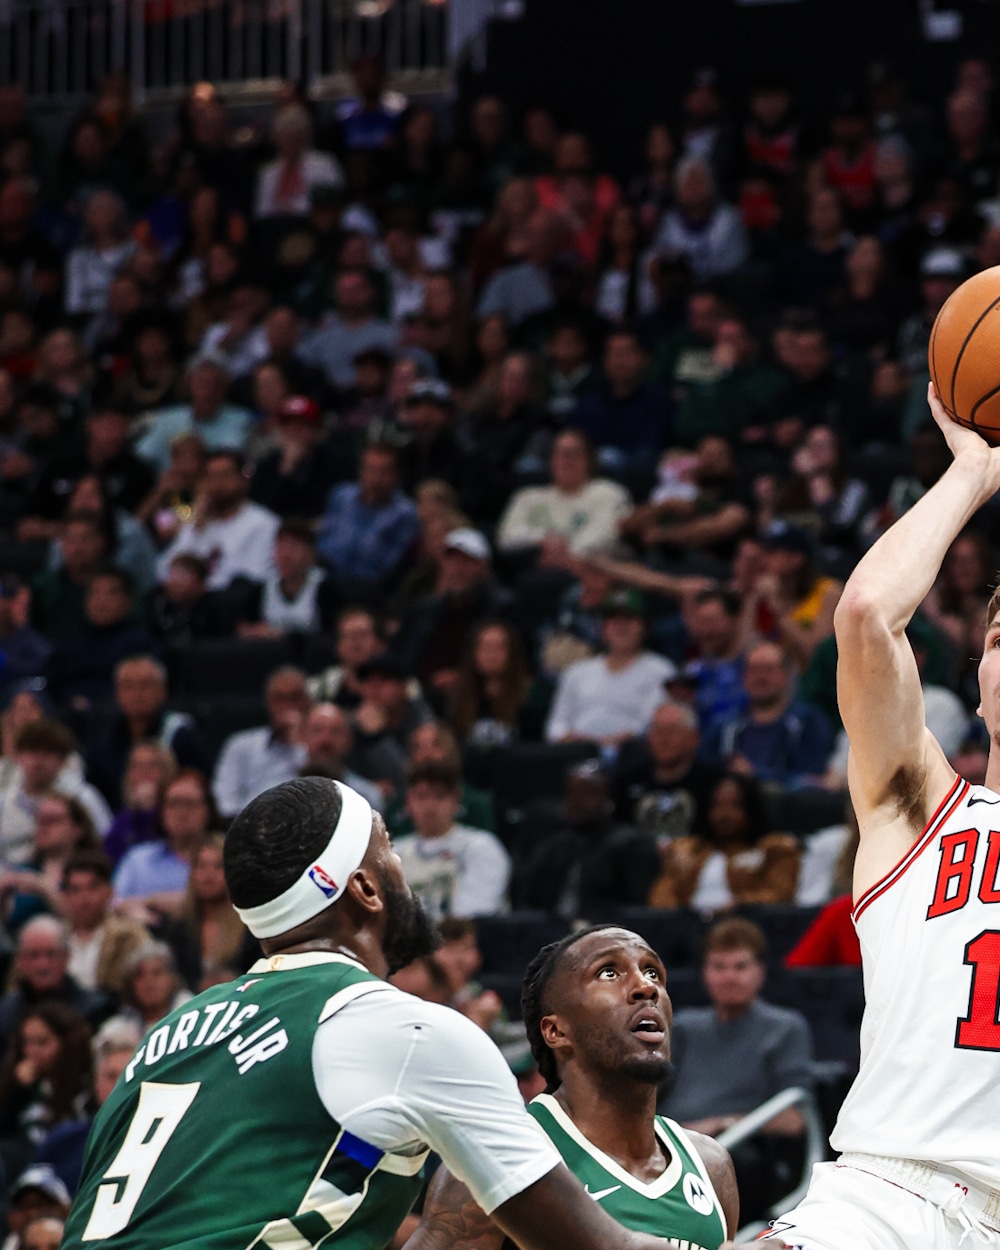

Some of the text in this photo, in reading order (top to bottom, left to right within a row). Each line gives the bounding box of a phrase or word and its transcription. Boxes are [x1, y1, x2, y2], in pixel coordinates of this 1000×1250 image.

[125, 1000, 290, 1083] PORTIS JR
[81, 1081, 202, 1242] 9
